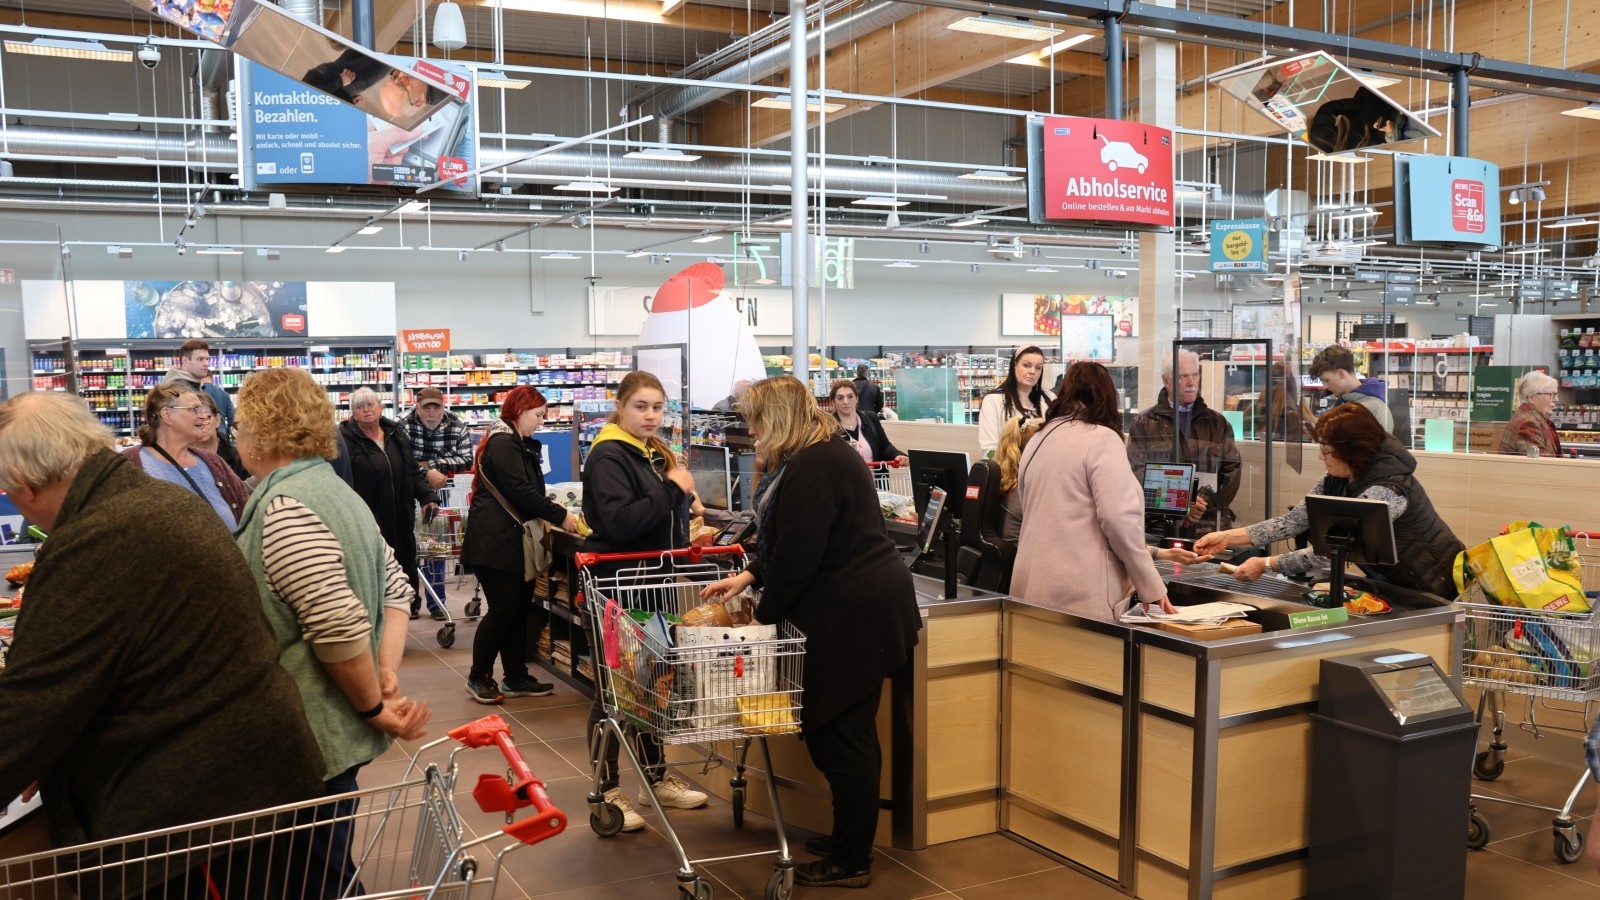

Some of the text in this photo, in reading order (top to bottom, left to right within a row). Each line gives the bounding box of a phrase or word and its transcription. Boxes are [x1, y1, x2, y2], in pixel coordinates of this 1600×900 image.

[254, 90, 341, 106] Kontaktloses
[255, 109, 319, 124] Bezahlen.
[279, 166, 298, 175] oder
[1066, 176, 1168, 203] Abholservice
[1455, 193, 1477, 208] Scan
[1062, 202, 1087, 211] Online
[1088, 202, 1119, 212] bestellen
[1136, 205, 1152, 214] Markt
[1152, 207, 1170, 216] abholen
[1466, 208, 1484, 223] &Go
[1215, 222, 1260, 231] Expresskasse
[407, 331, 446, 342] AIRBRUSH
[412, 340, 441, 349] TATTOO
[1543, 596, 1569, 611] REWE
